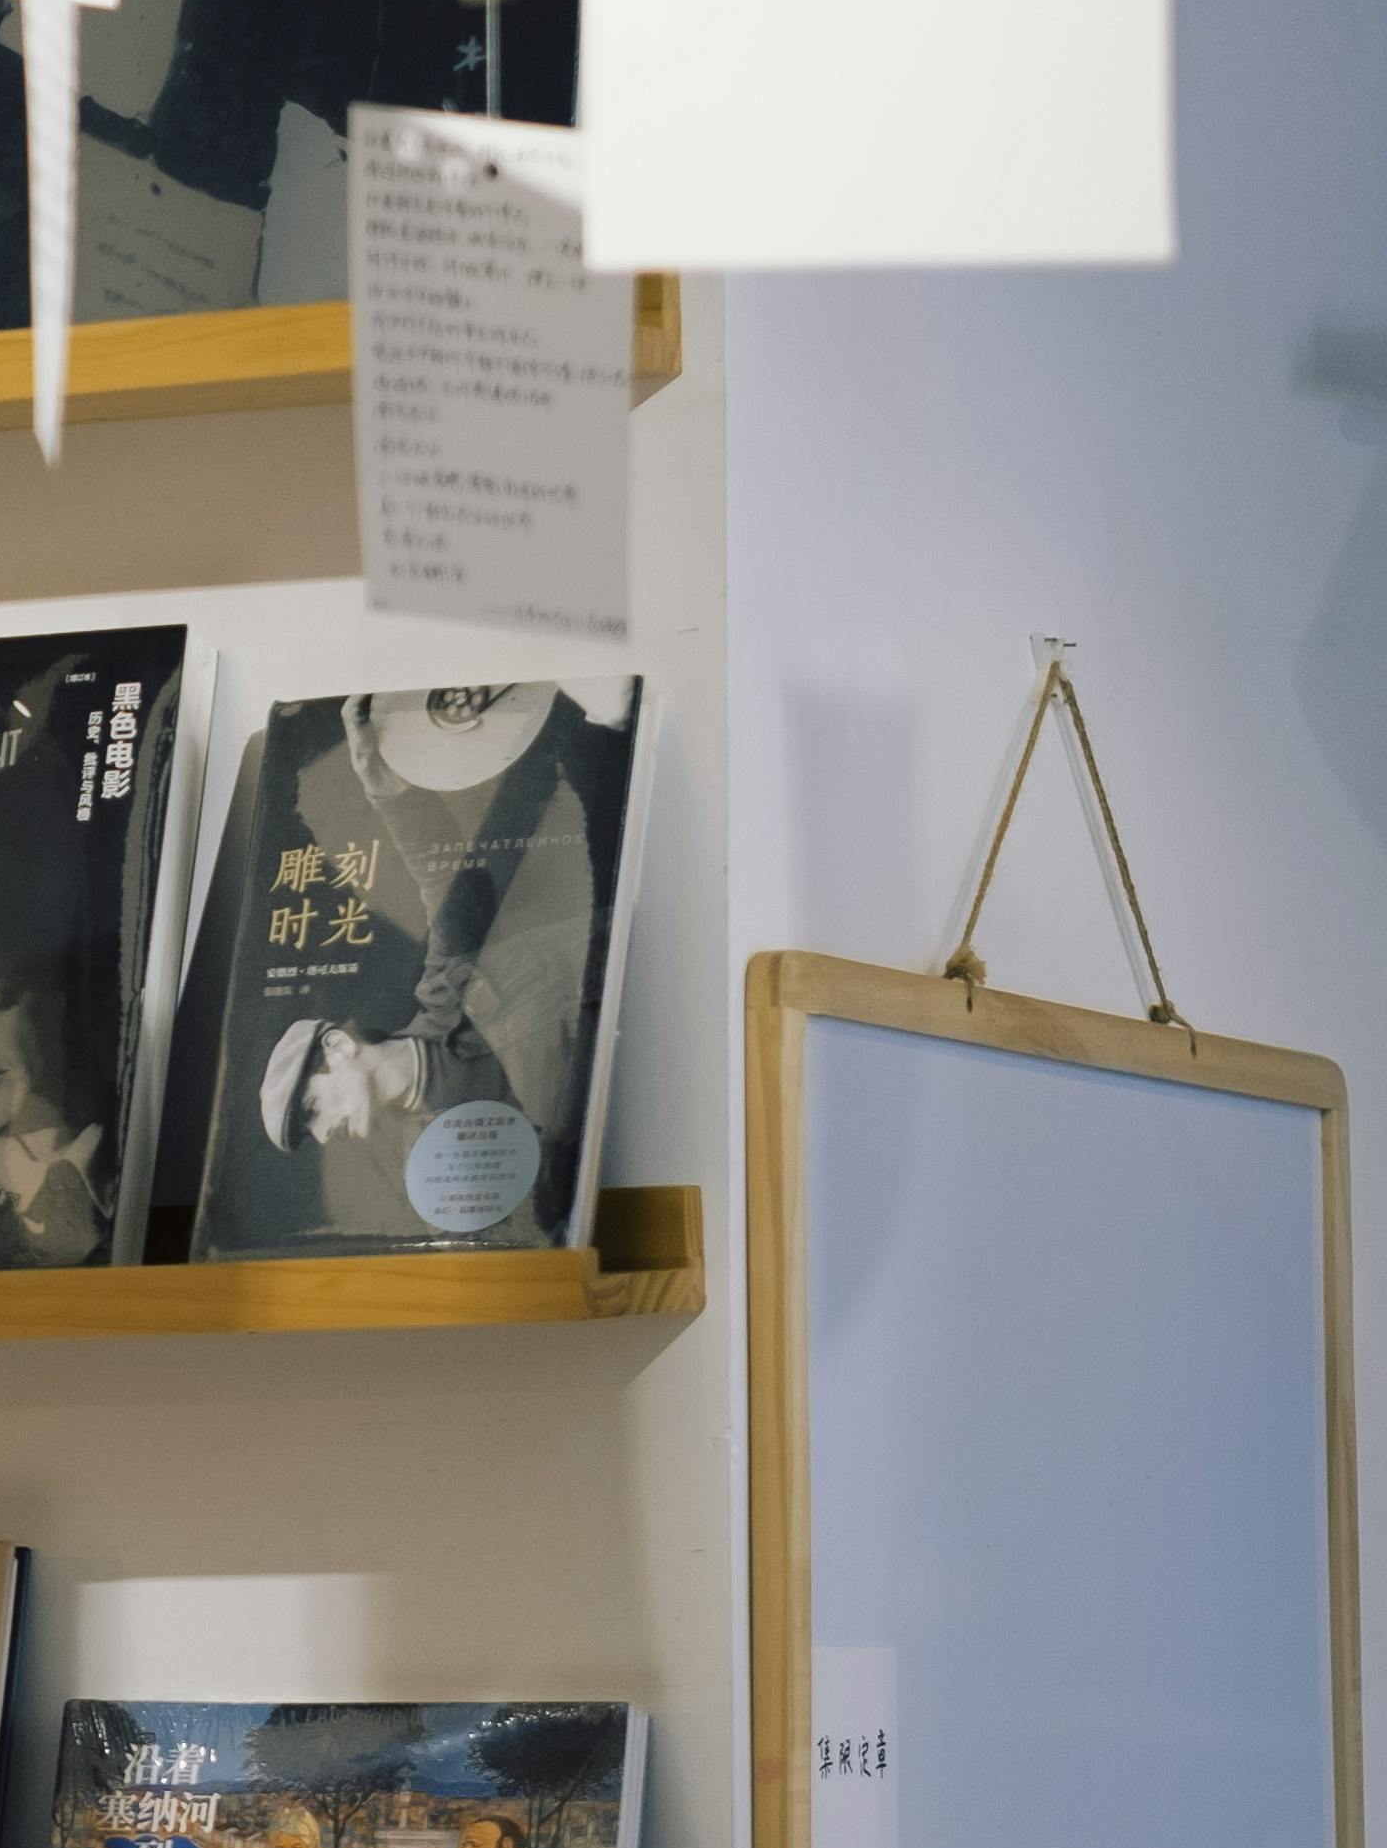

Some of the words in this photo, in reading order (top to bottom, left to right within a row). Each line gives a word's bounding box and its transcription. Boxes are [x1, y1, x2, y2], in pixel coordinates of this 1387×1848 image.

[101, 682, 141, 800] 黑色电影
[268, 839, 380, 895] 雕刻
[267, 897, 375, 951] 时光
[123, 1742, 207, 1785] 沿着
[97, 1790, 221, 1834] 塞纳河
